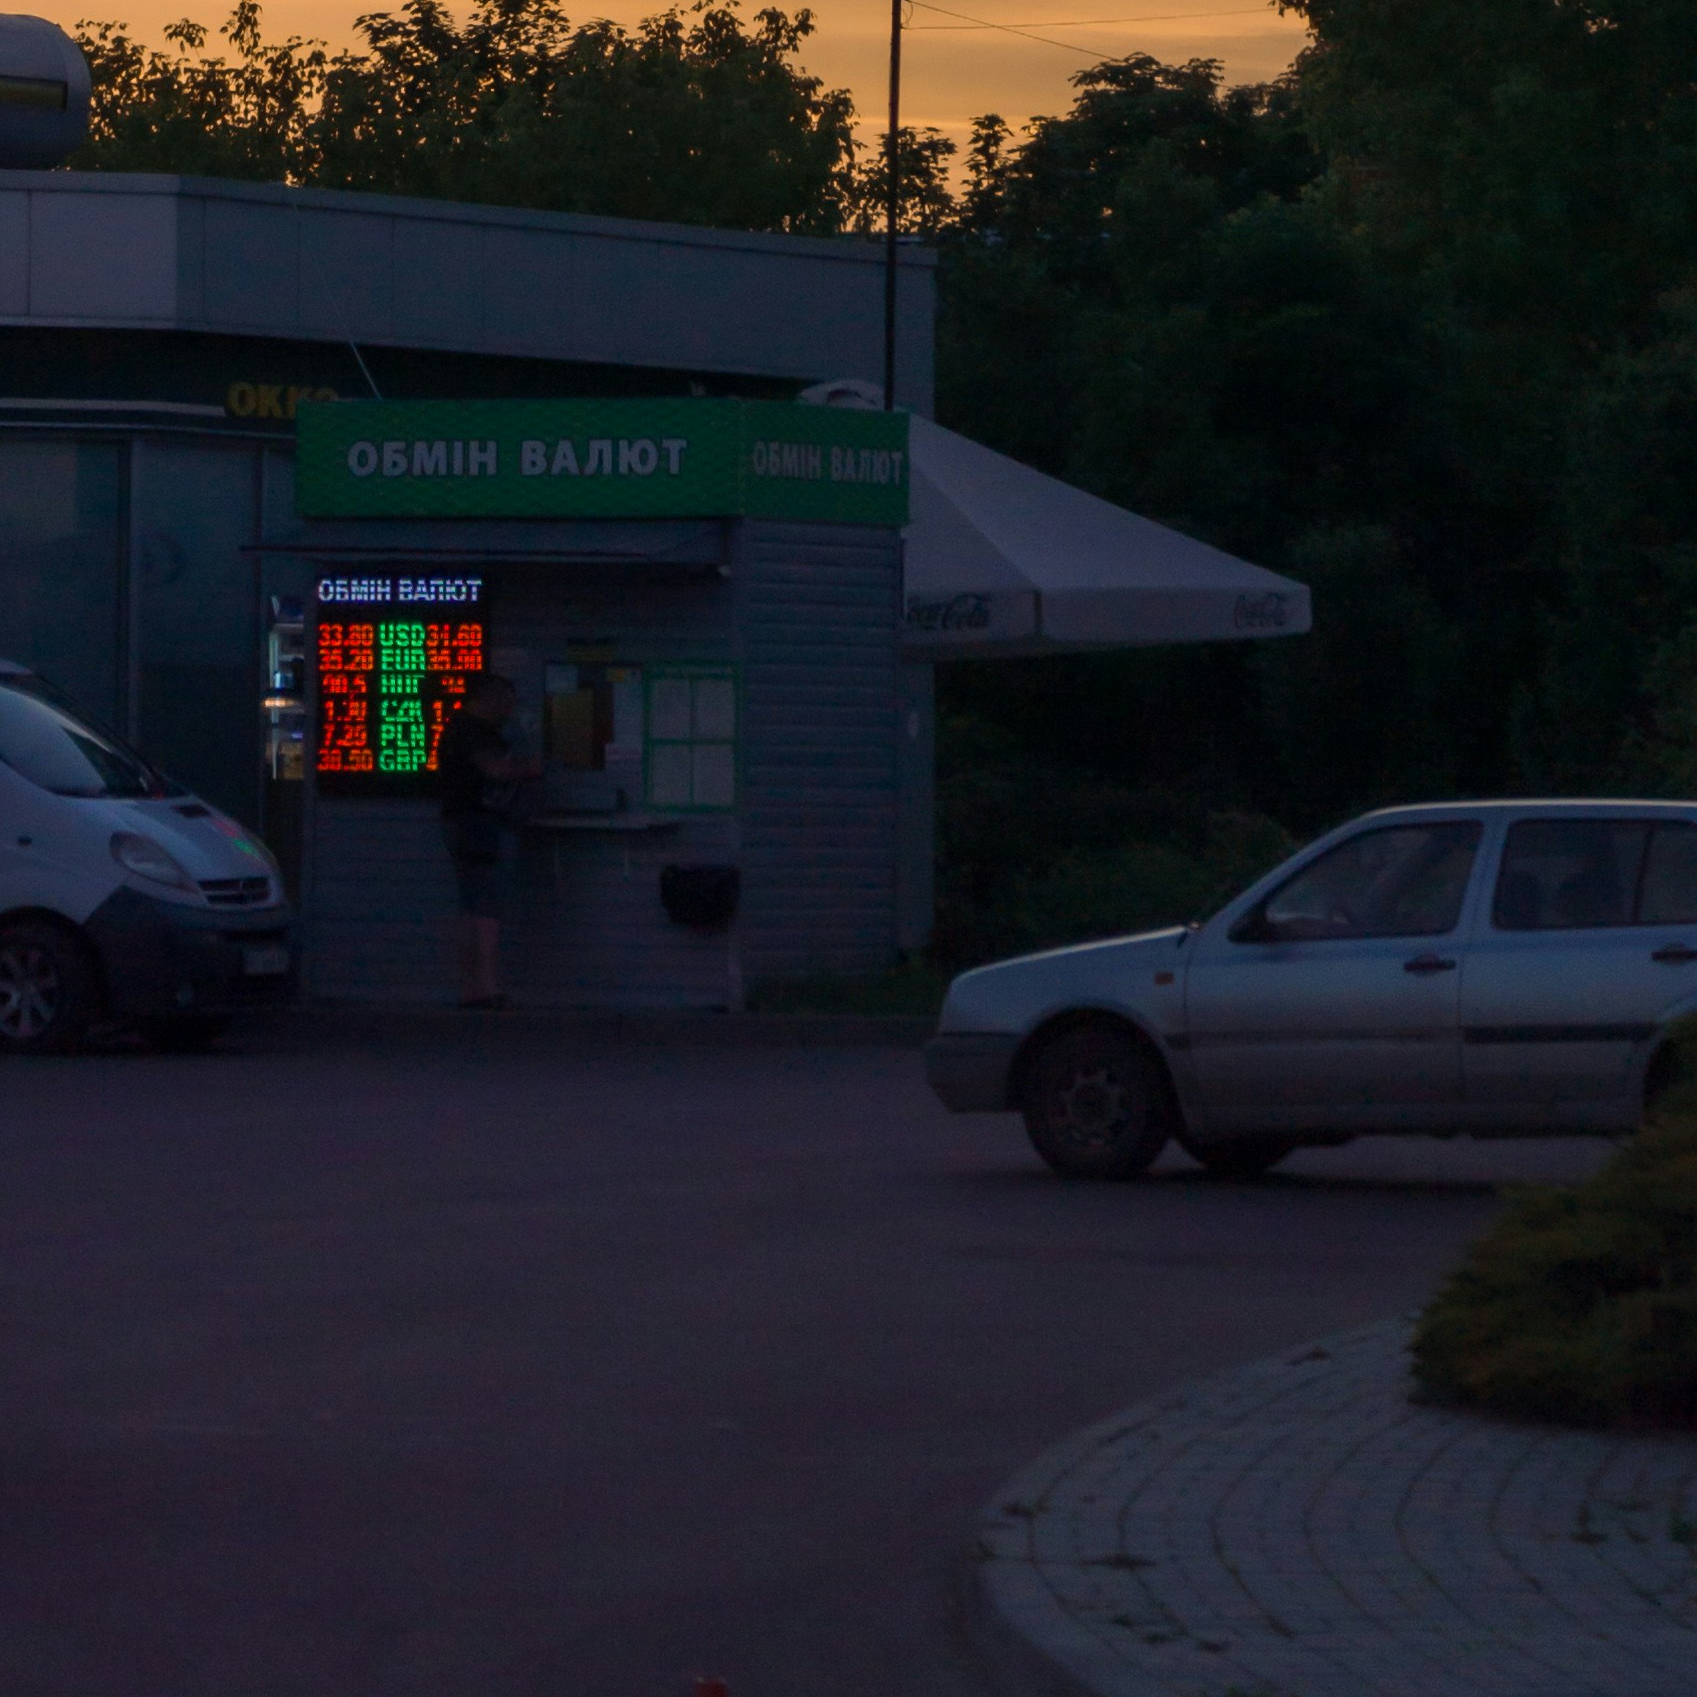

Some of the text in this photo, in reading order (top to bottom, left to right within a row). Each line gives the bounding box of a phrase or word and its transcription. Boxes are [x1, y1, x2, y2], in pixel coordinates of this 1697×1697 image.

[346, 438, 688, 477] ОБМІН ВАЛЮТ
[752, 440, 903, 486] ОБМІН ВАЛЮТ
[318, 579, 391, 602] ОБМІН
[380, 624, 425, 646] USD
[381, 649, 425, 670] EUR
[382, 724, 425, 746] PLN
[380, 749, 426, 771] GBP
